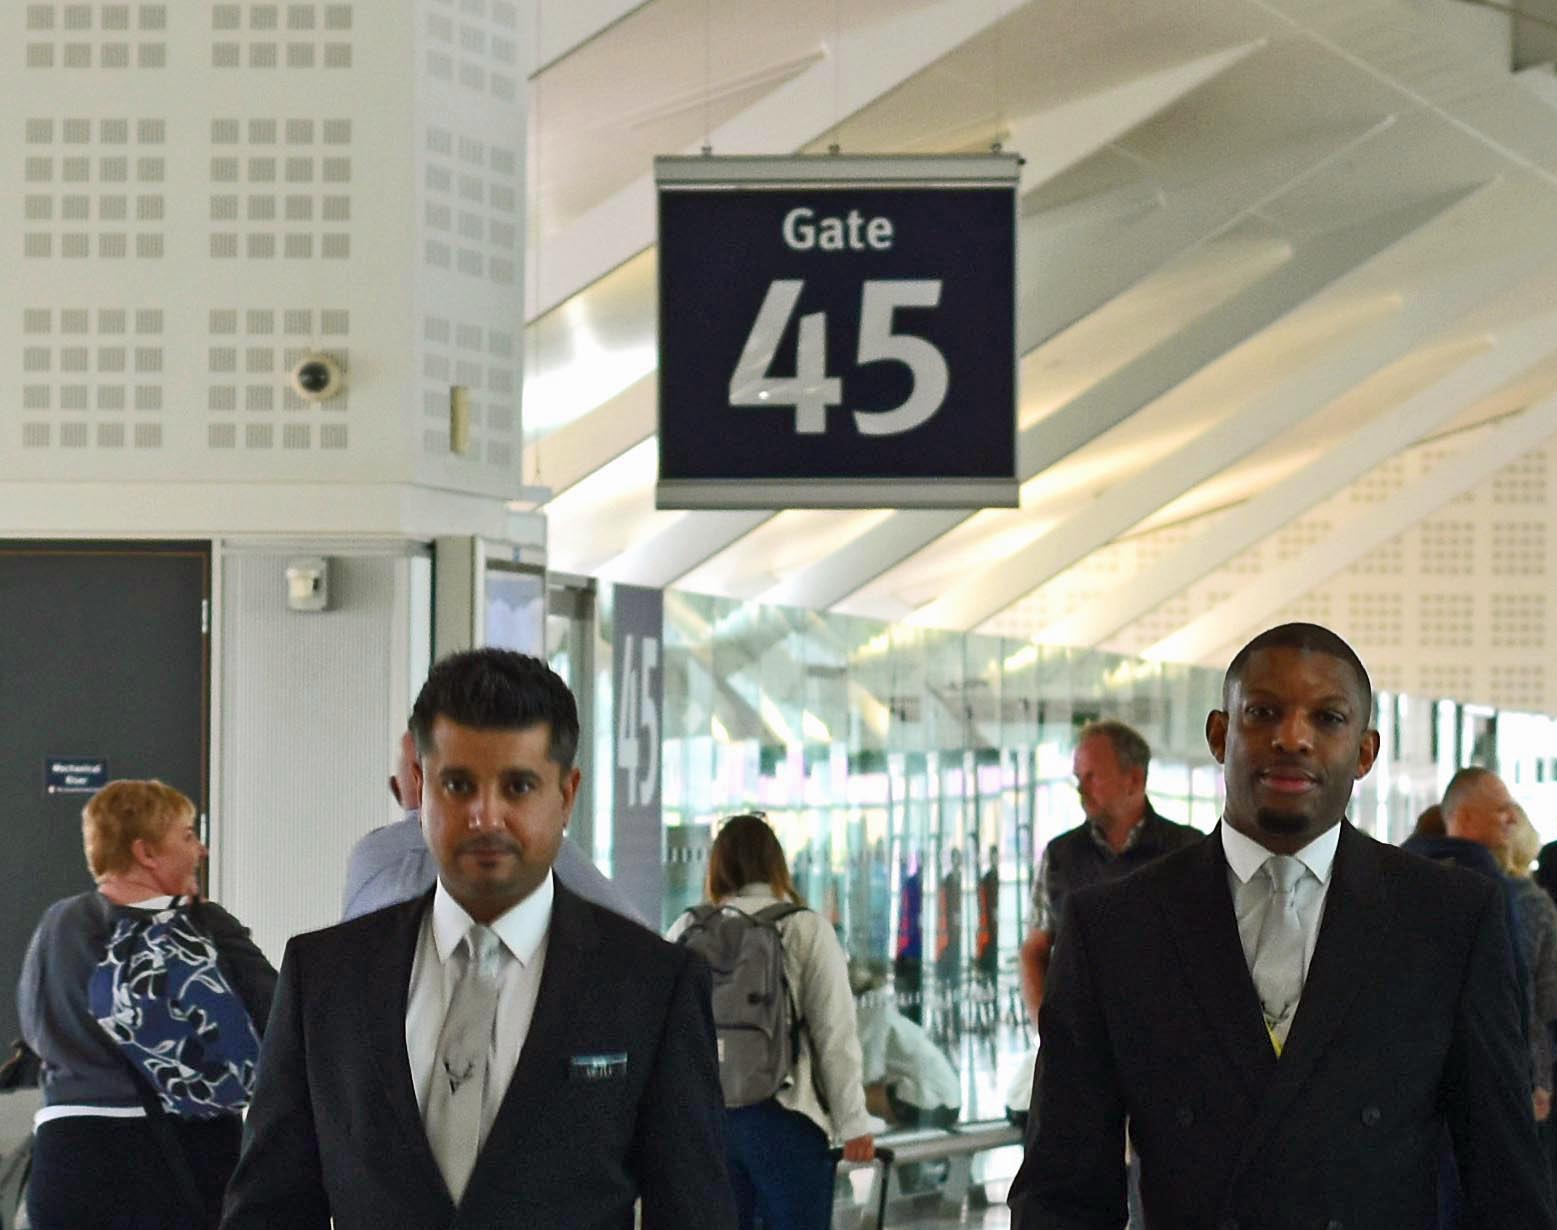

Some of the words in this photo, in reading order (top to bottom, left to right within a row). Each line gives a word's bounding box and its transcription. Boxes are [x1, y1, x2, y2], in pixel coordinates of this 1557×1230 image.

[782, 206, 895, 251] Gate
[728, 279, 950, 436] 45
[618, 633, 659, 807] 45
